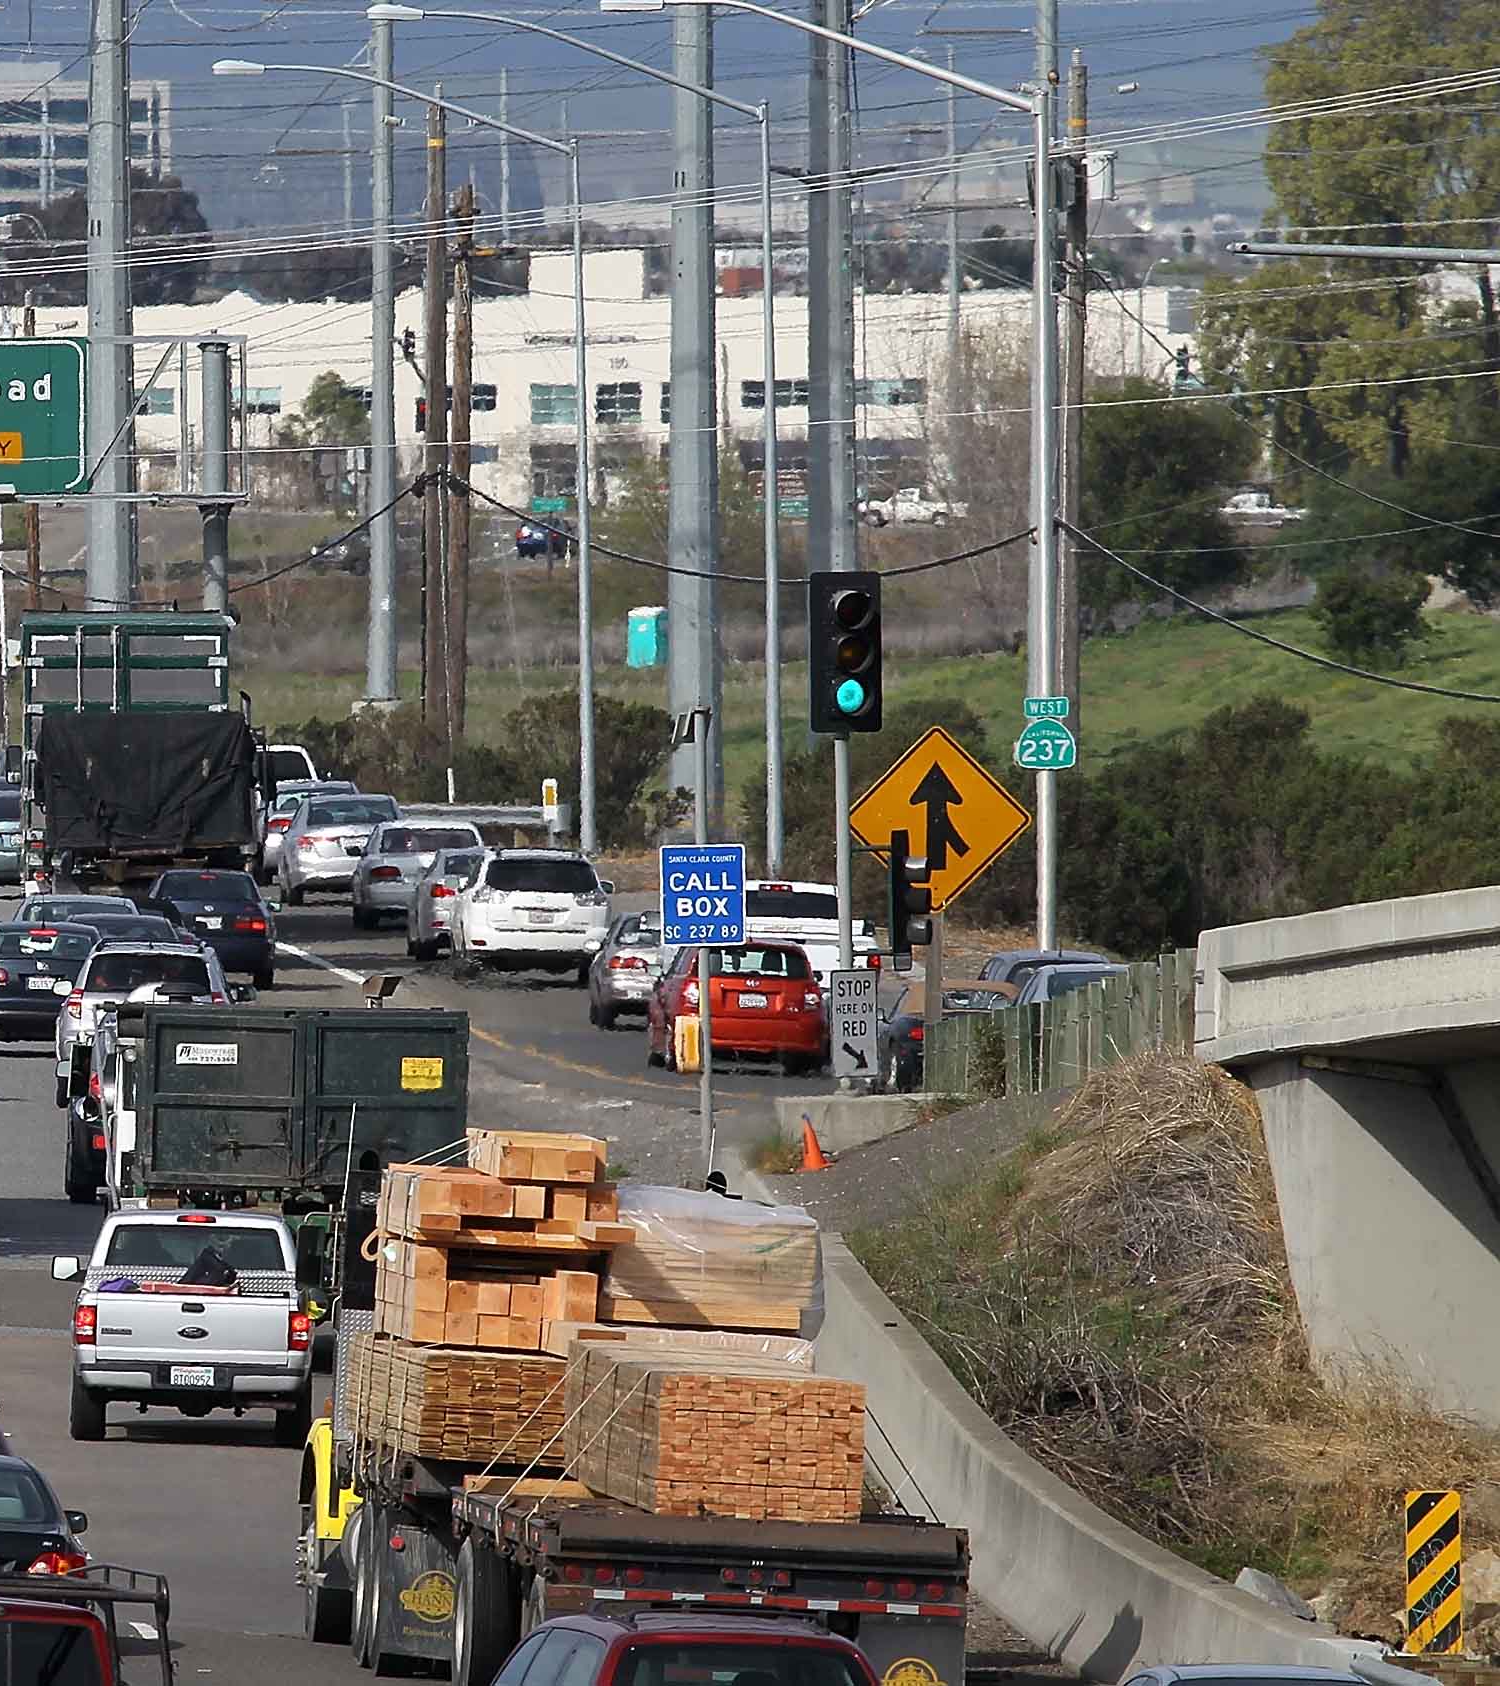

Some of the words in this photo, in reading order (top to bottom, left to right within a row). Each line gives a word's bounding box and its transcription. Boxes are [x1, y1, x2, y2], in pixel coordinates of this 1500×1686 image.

[1028, 701, 1063, 714] WEST
[1021, 739, 1070, 762] 237
[668, 855, 687, 864] SANTA
[689, 855, 710, 863] CLARA
[711, 855, 736, 863] COUNTY
[669, 871, 737, 892] CALL
[676, 896, 729, 917] BOX
[665, 925, 681, 939] SC
[689, 924, 715, 939] 237
[721, 924, 738, 938] 89
[837, 980, 871, 997] STOP
[836, 1003, 858, 1014] HERE
[861, 1003, 874, 1014] ON
[842, 1020, 867, 1037] RED
